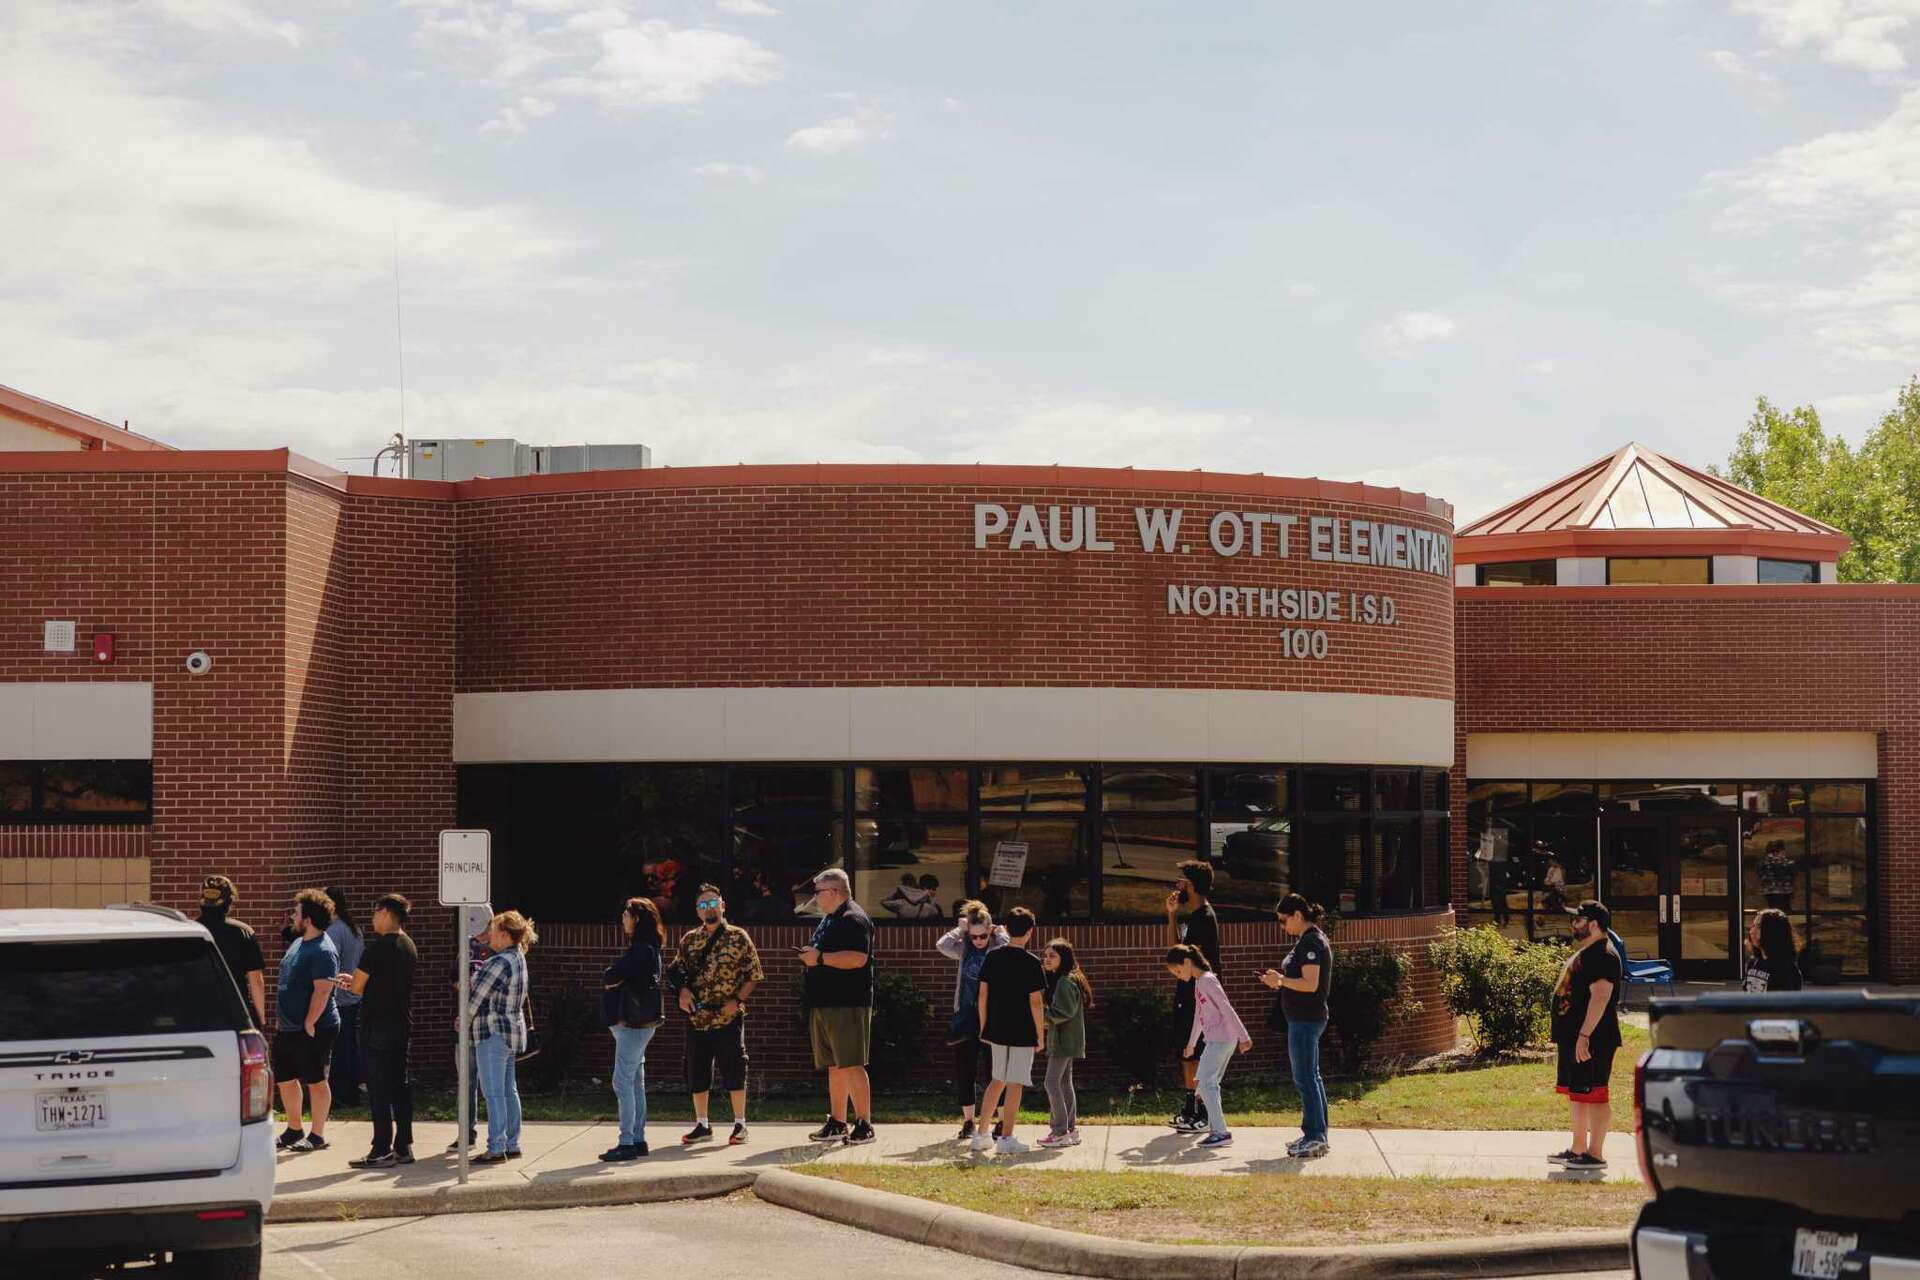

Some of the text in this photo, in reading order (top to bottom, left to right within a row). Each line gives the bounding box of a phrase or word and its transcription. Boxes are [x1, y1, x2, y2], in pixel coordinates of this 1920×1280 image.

[974, 503, 1452, 577] PAUL W. OTT ELEMENTAR
[1167, 584, 1400, 625] NORTHSIDE I.S.D.
[1280, 628, 1329, 660] 100
[443, 862, 486, 874] PRINCIPAL
[33, 1070, 115, 1080] TAHOE
[60, 1095, 87, 1103] TEXAS
